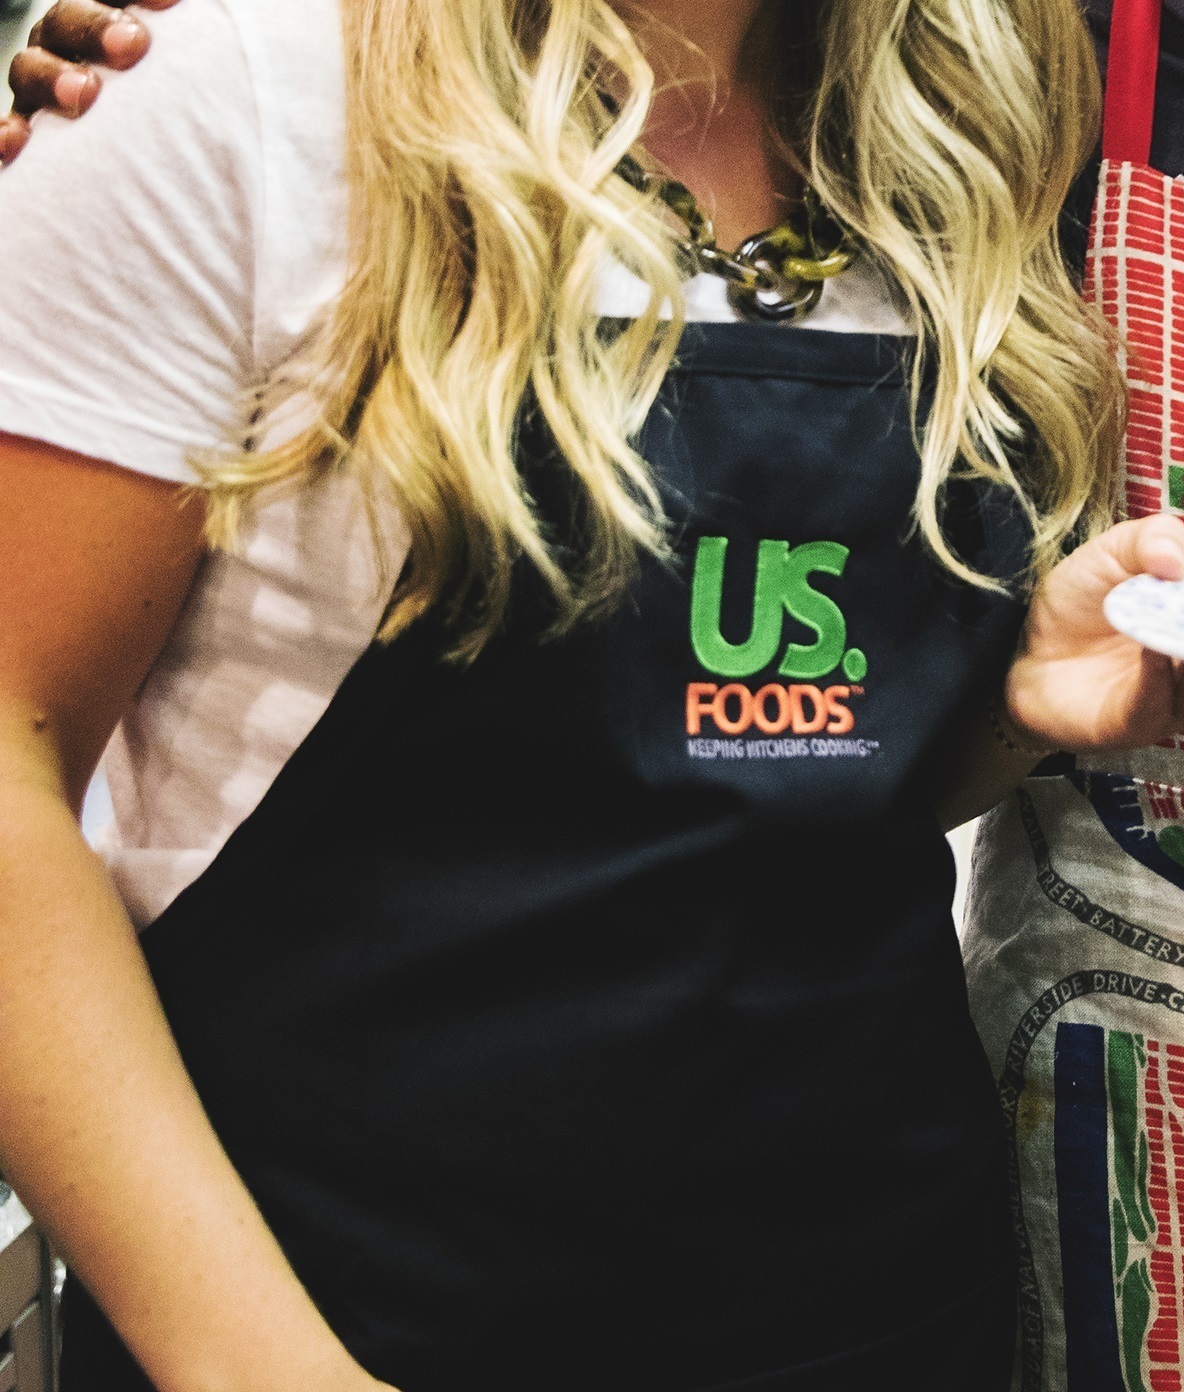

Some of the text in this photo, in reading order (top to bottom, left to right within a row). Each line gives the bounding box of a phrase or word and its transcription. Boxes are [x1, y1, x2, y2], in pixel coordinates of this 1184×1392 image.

[687, 738, 745, 760] KEEPING
[746, 738, 810, 759] KITCHENS
[1008, 972, 1158, 1075] RIVERSIDE DRIVE
